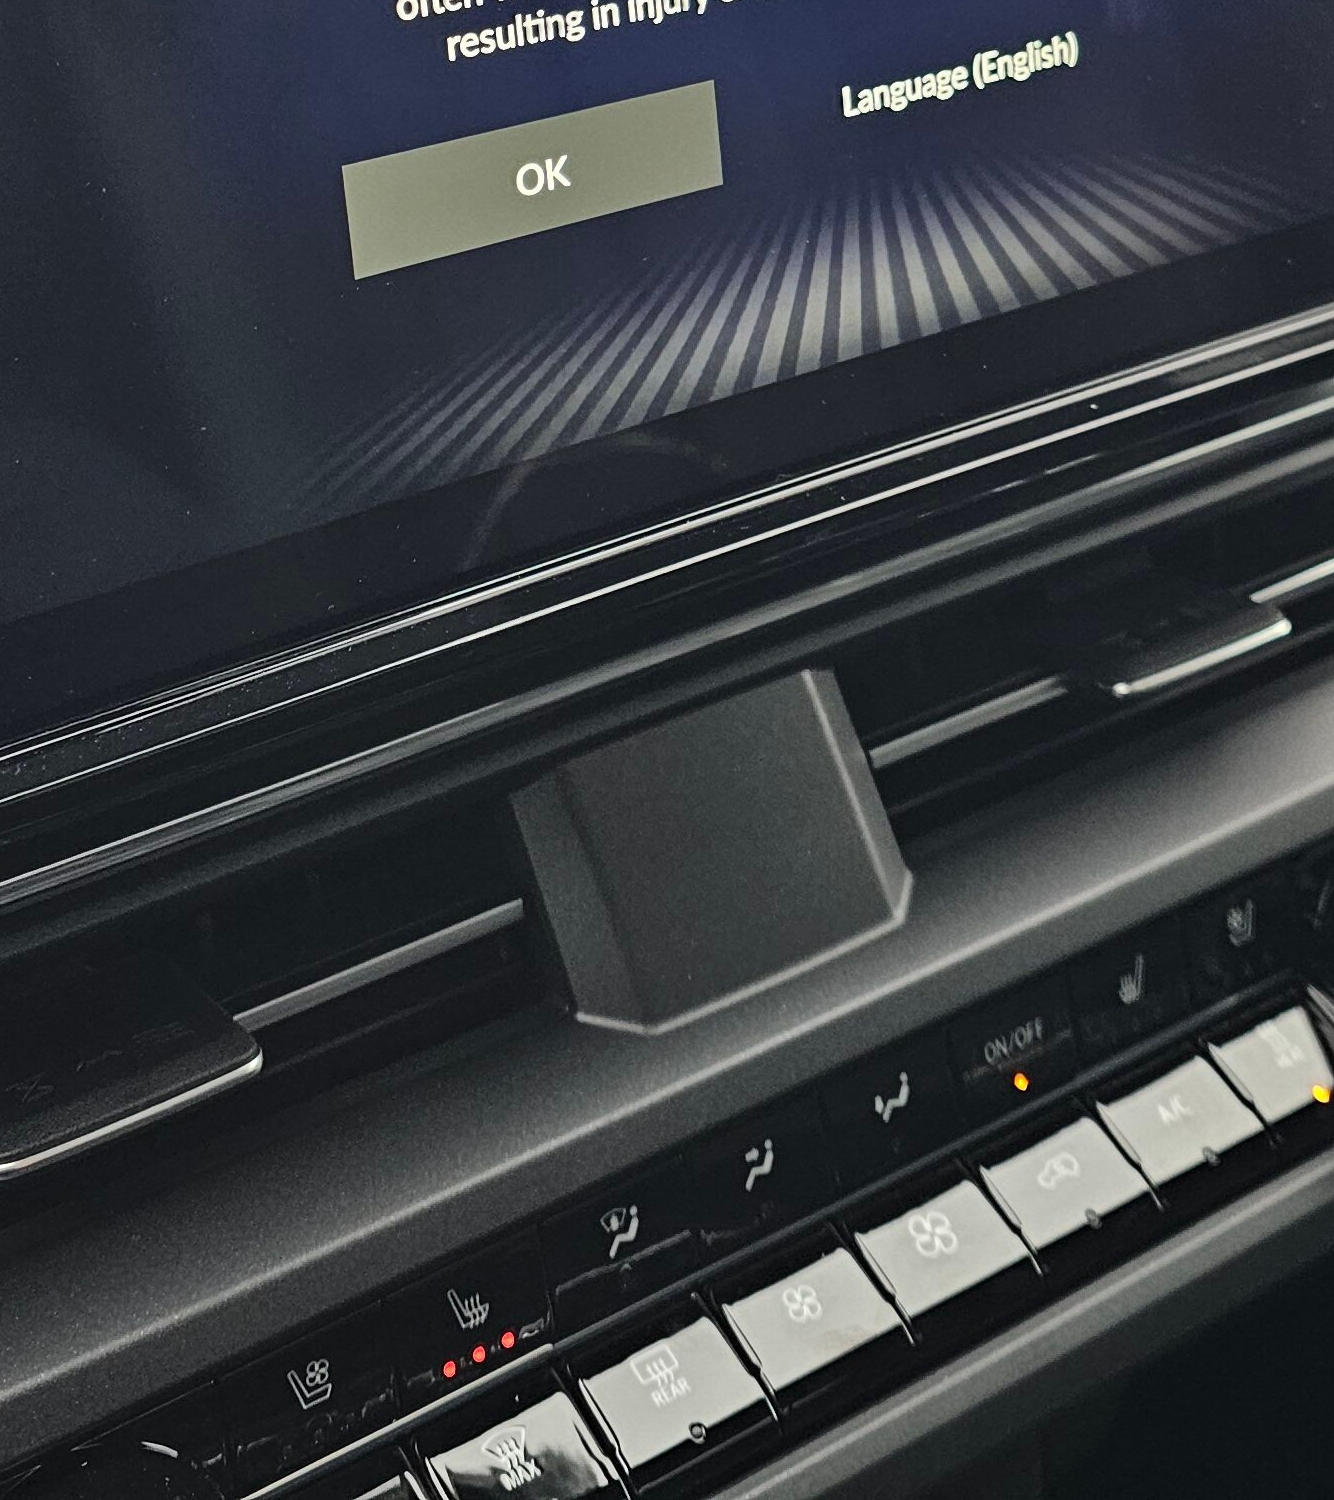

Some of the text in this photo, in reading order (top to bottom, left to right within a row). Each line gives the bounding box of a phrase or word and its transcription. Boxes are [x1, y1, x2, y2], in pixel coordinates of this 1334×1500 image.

[446, 9, 585, 62] resulting
[841, 31, 1079, 118] Language (English)
[516, 154, 572, 196] OK
[499, 1458, 542, 1492] MAX
